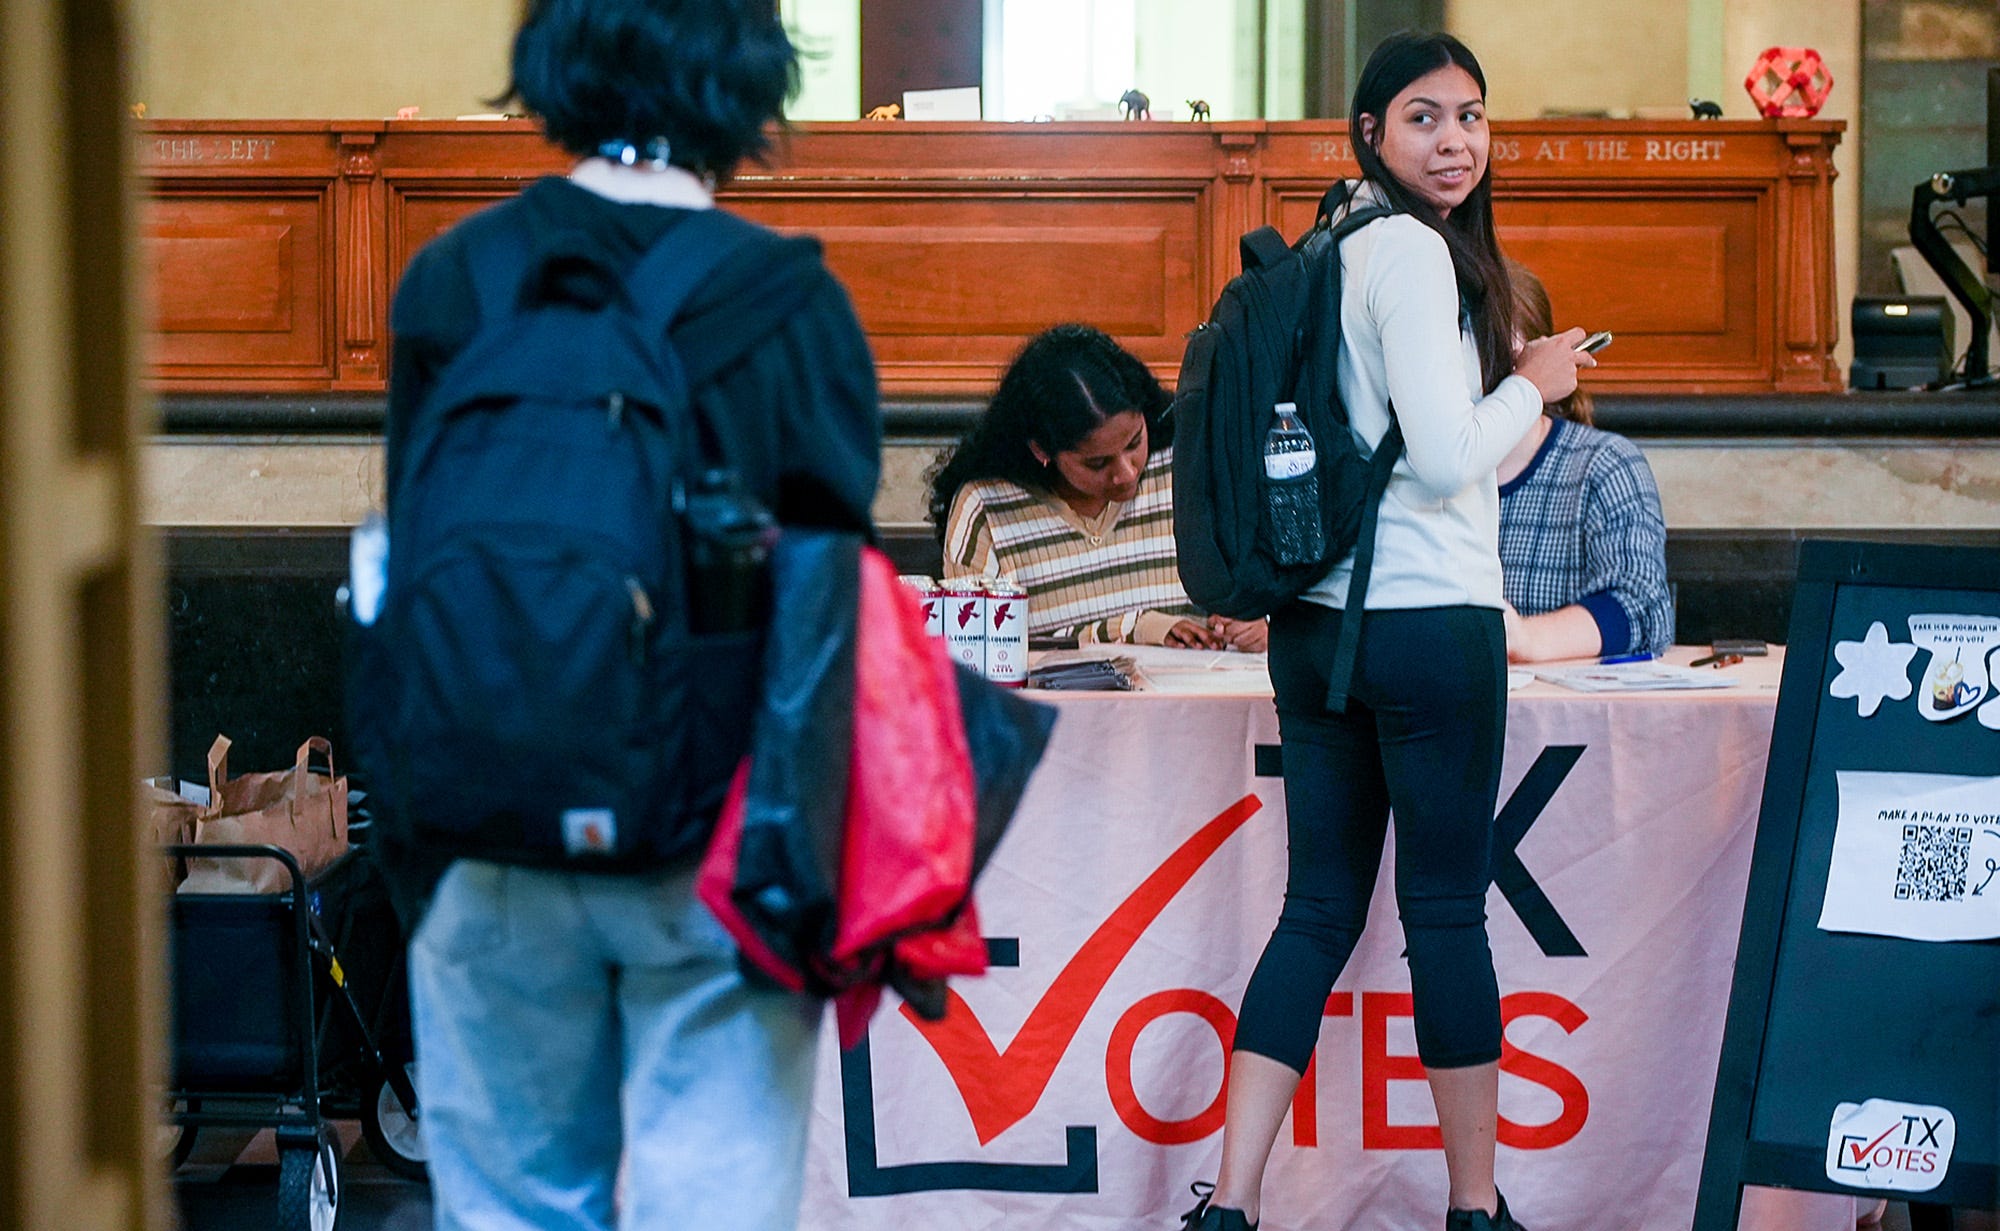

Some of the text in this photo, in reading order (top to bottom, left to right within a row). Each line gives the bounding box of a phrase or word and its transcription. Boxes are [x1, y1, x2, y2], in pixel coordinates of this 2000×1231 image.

[157, 139, 275, 160] THE LEFT
[1535, 140, 1570, 161] AT
[1584, 140, 1631, 161] THE
[1645, 140, 1726, 161] RIGHT
[1979, 624, 1998, 632] WITH
[1966, 635, 1984, 643] VOTE
[1877, 809, 1907, 821] MAKE
[1910, 811, 1918, 821] A
[1921, 811, 1951, 823] PLAN
[1955, 813, 1969, 823] TO
[1902, 1115, 1944, 1148] TX
